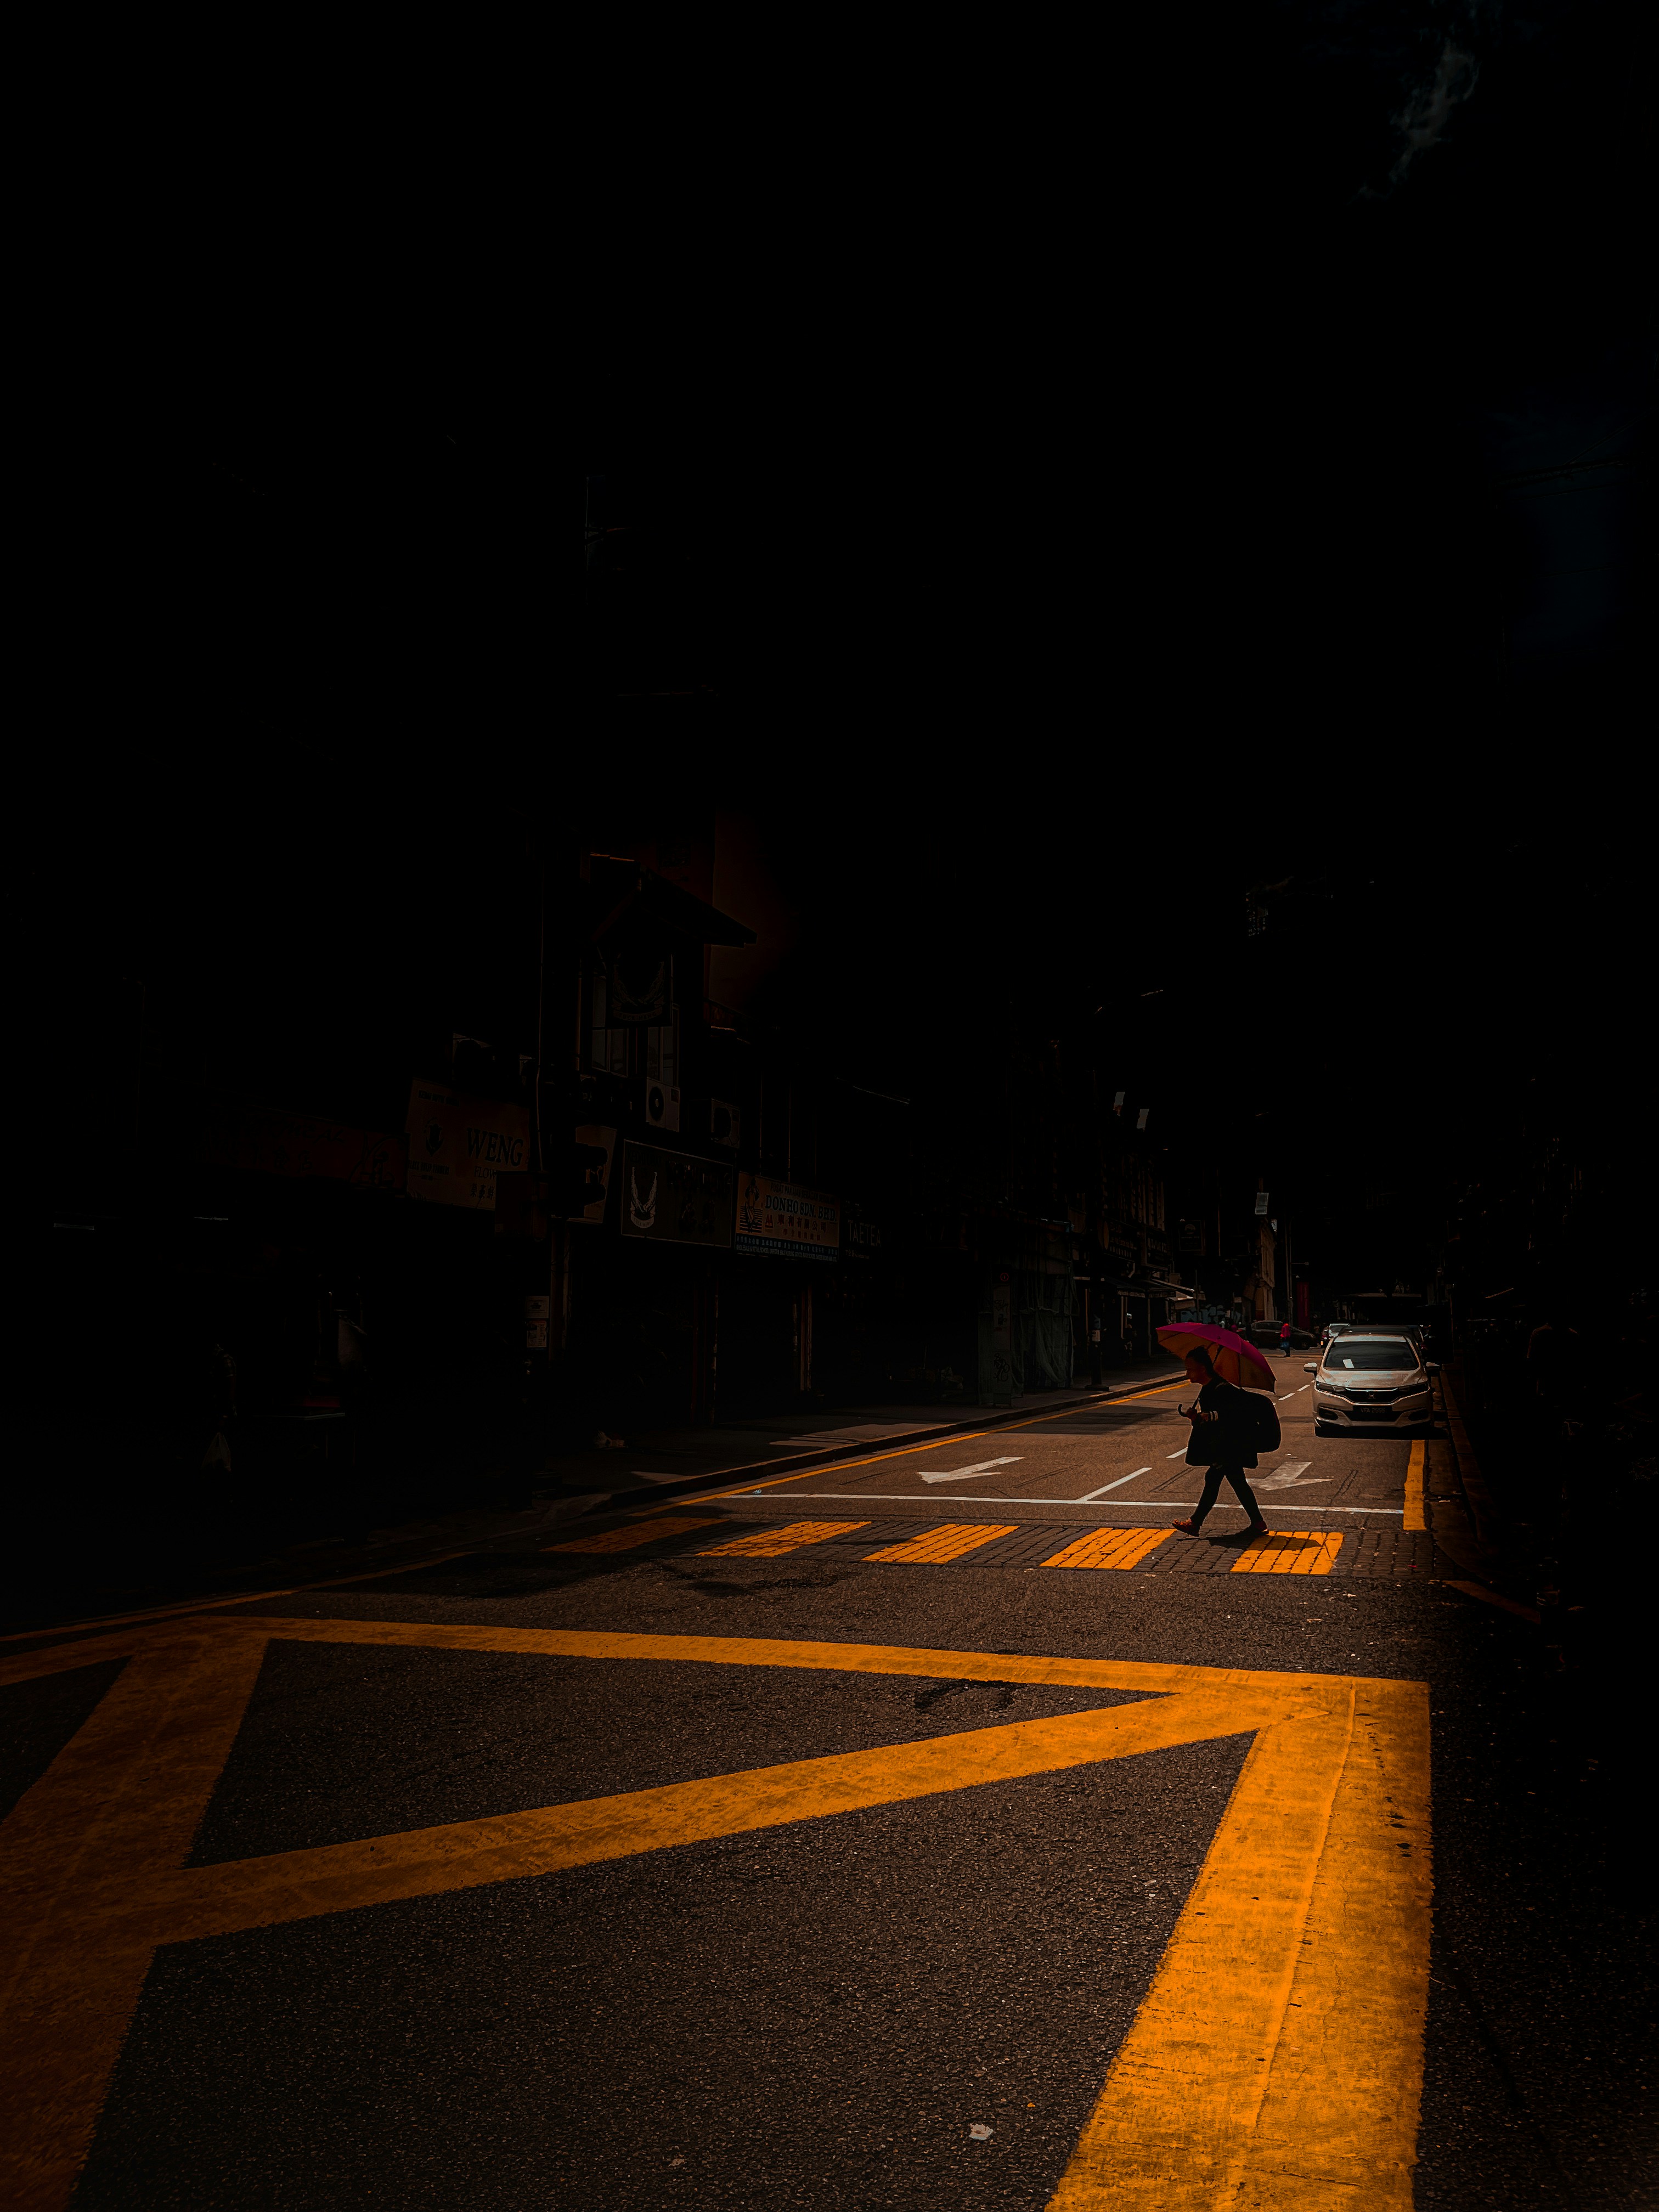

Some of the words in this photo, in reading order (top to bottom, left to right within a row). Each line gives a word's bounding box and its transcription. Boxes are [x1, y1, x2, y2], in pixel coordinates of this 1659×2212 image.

[466, 1127, 524, 1166] WENG
[765, 1194, 799, 1214] DONHO
[800, 1201, 817, 1218] SDN.
[817, 1206, 838, 1223] BHD.
[847, 1219, 882, 1248] TAETEA
